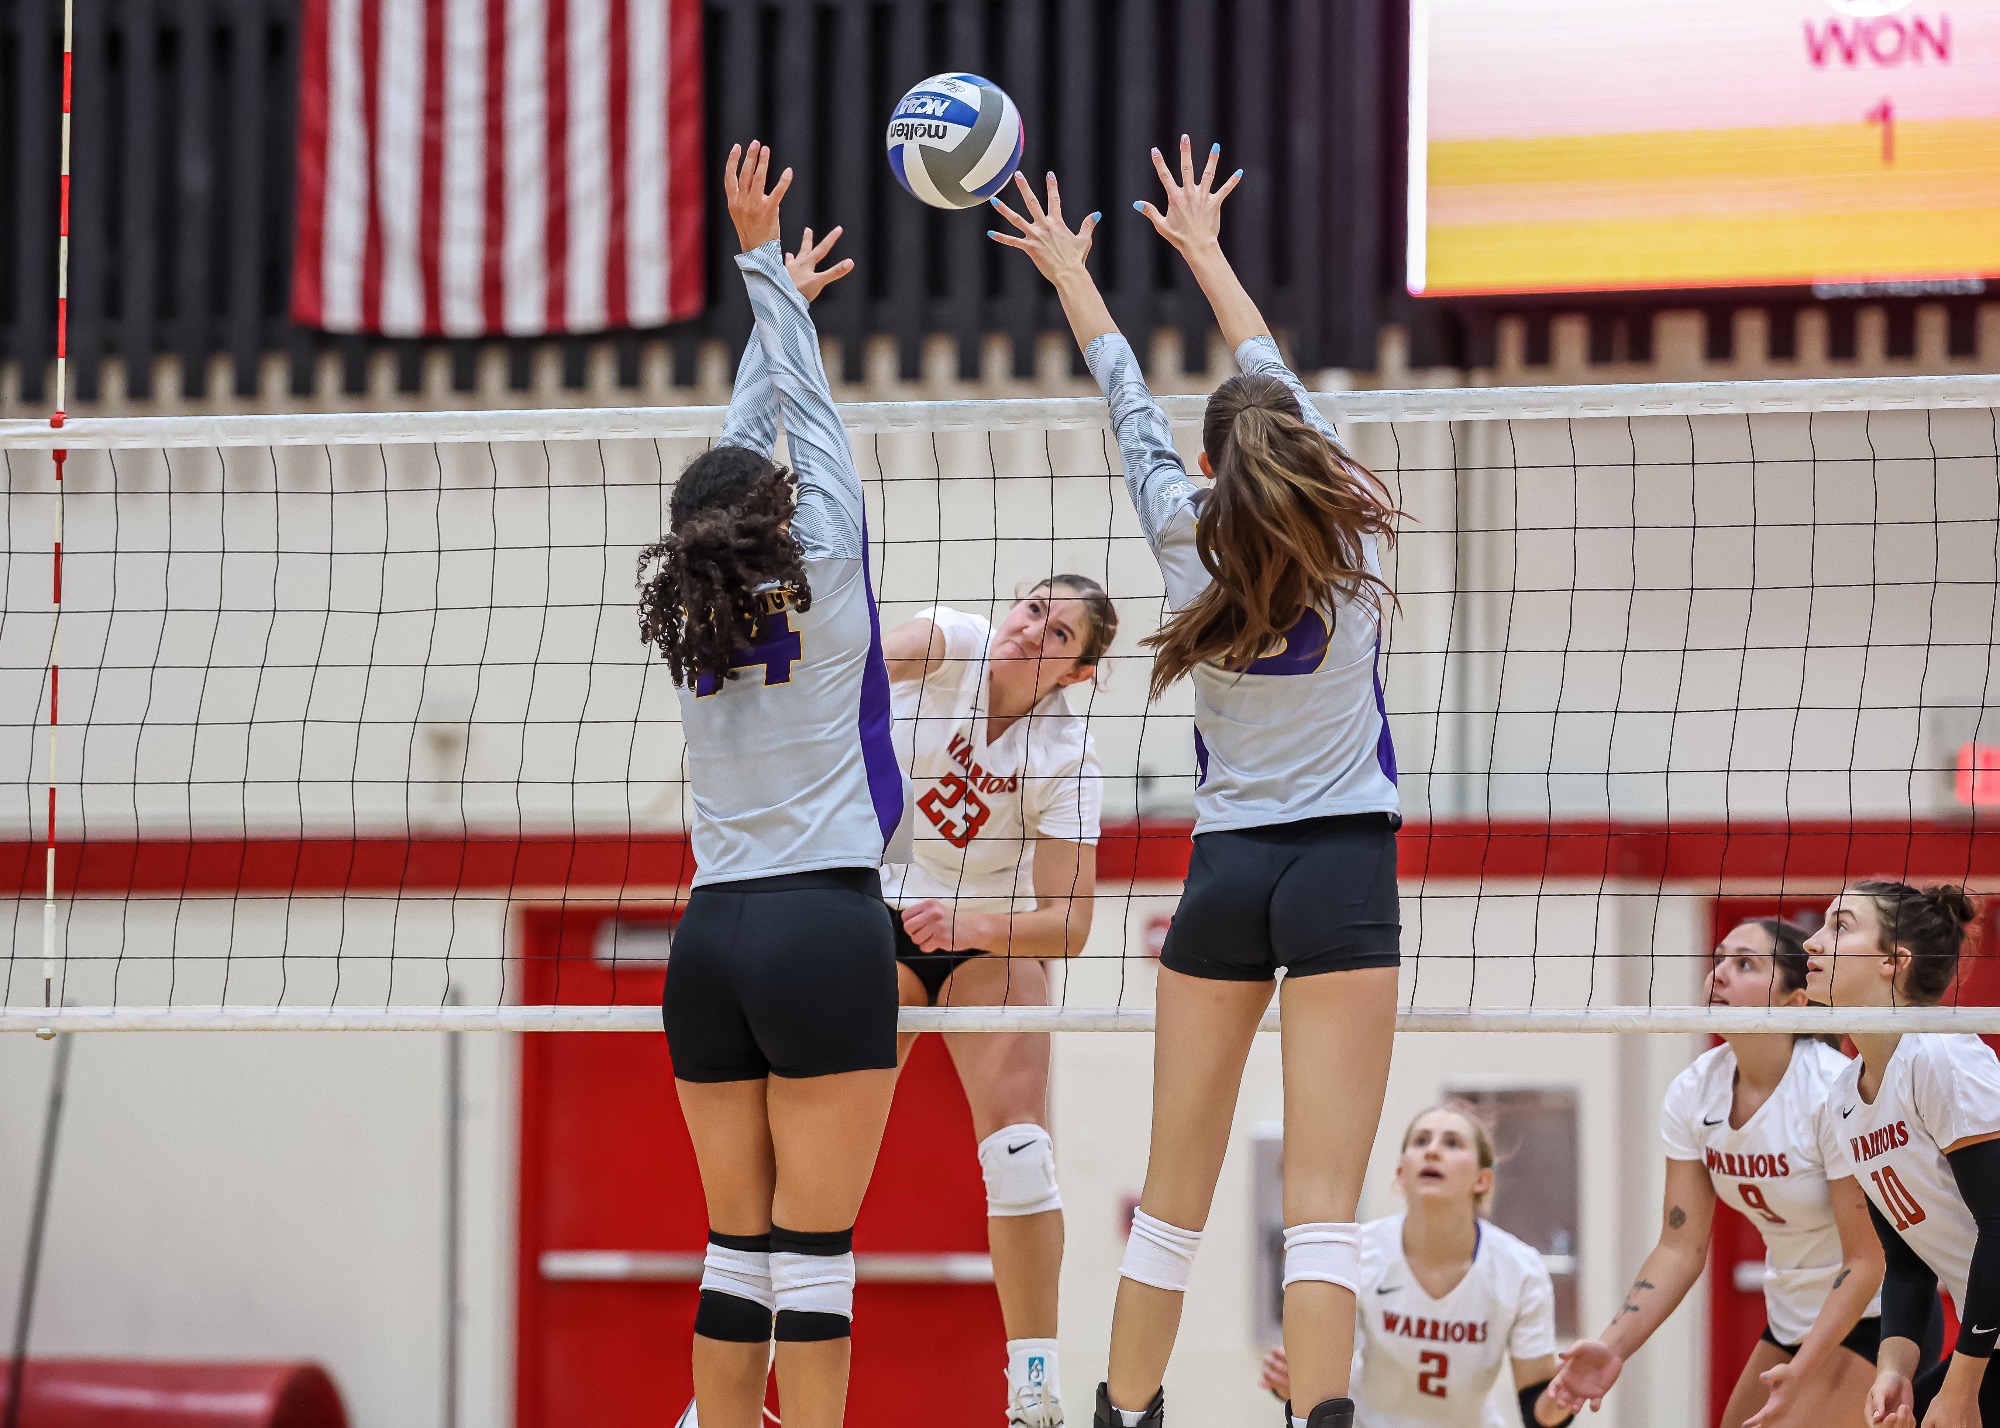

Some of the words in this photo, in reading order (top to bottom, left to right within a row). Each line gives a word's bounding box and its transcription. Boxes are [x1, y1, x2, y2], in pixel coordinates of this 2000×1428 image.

[1804, 14, 1951, 68] WON
[896, 98, 951, 118] NCAA
[890, 122, 948, 141] molten
[1864, 97, 1895, 166] 1
[916, 772, 991, 849] 23
[1706, 1147, 1790, 1178] WARRIORS
[1850, 1121, 1909, 1164] WARRIORS
[1738, 1183, 1786, 1224] 9
[1870, 1165, 1926, 1232] 10
[1382, 1310, 1488, 1344] WARRIORS
[1418, 1350, 1449, 1399] 2
